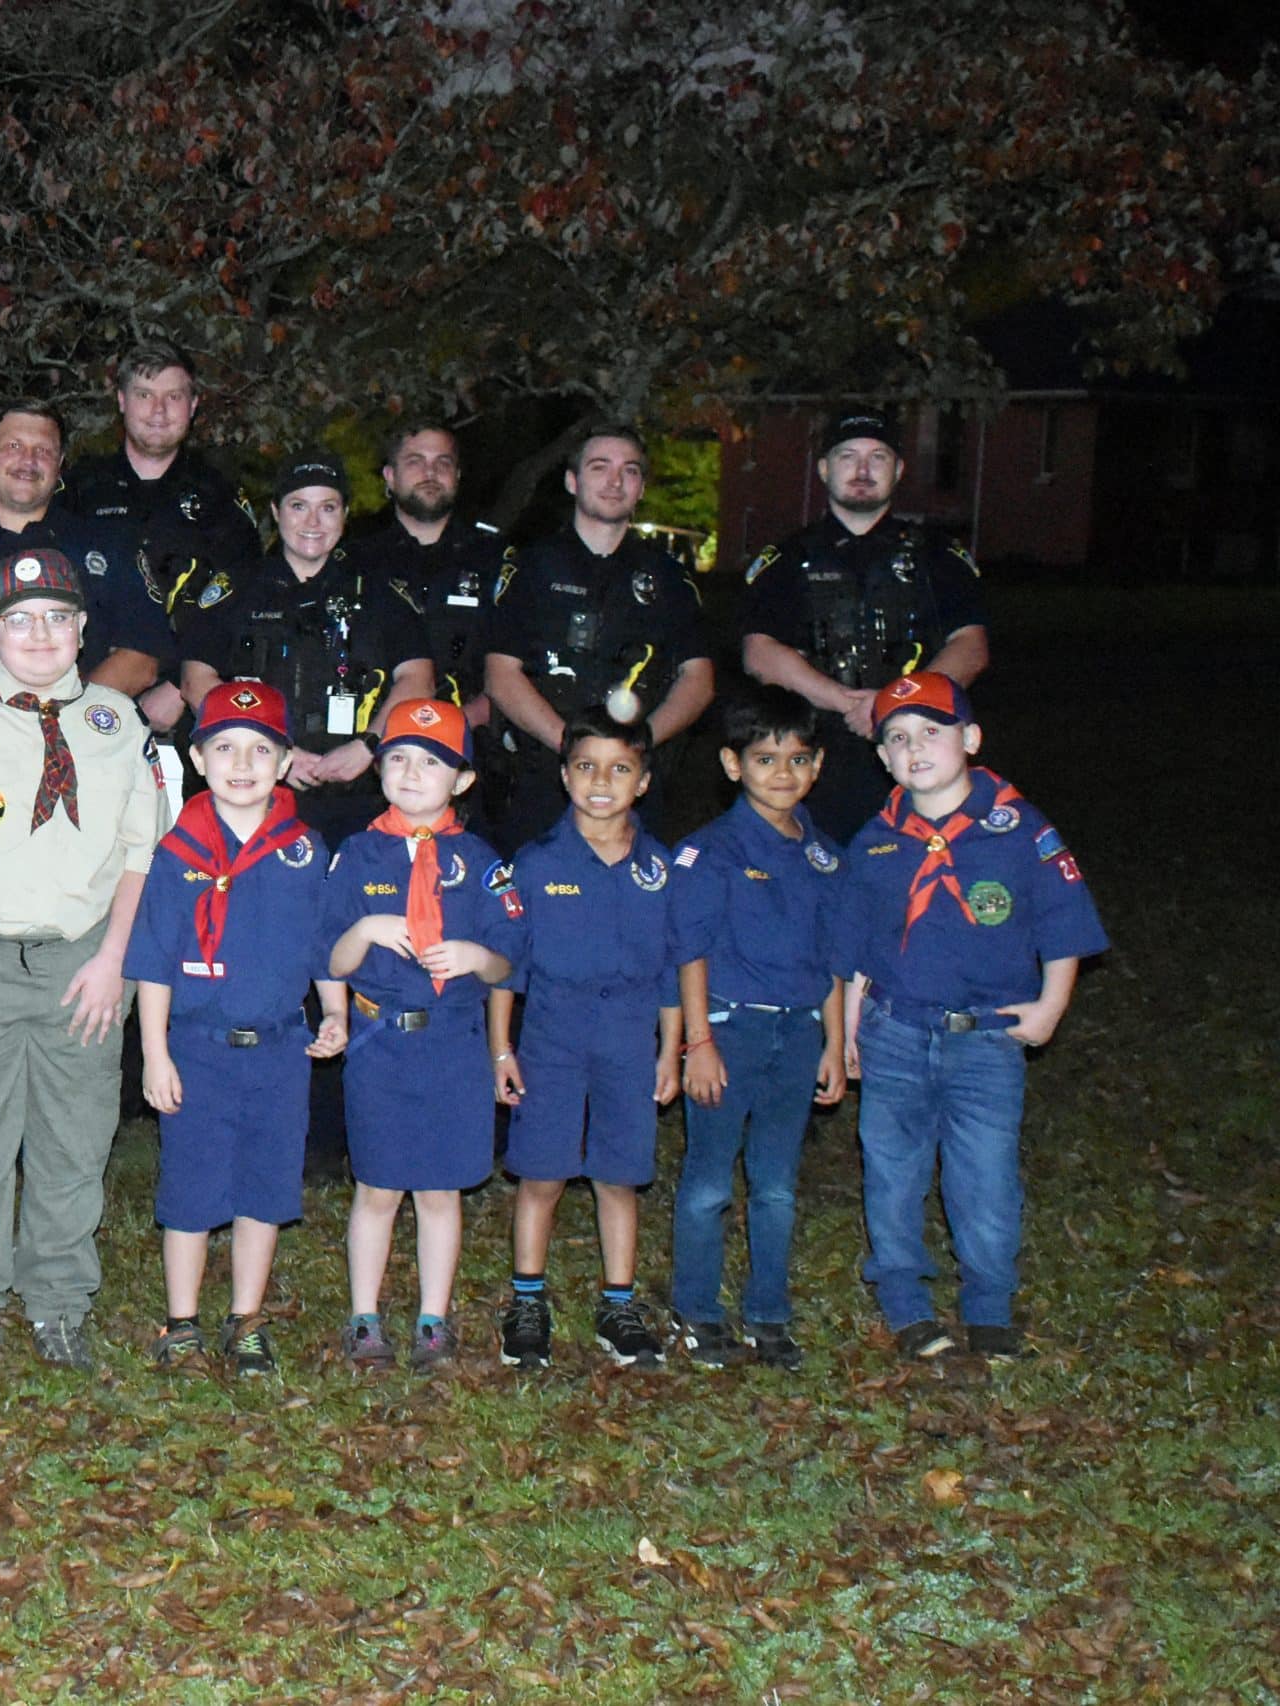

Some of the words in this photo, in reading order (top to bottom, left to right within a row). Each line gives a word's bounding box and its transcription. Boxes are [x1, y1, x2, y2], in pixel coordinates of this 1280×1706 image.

[197, 871, 214, 882] BS
[377, 884, 399, 896] BSA
[557, 884, 581, 896] BSA
